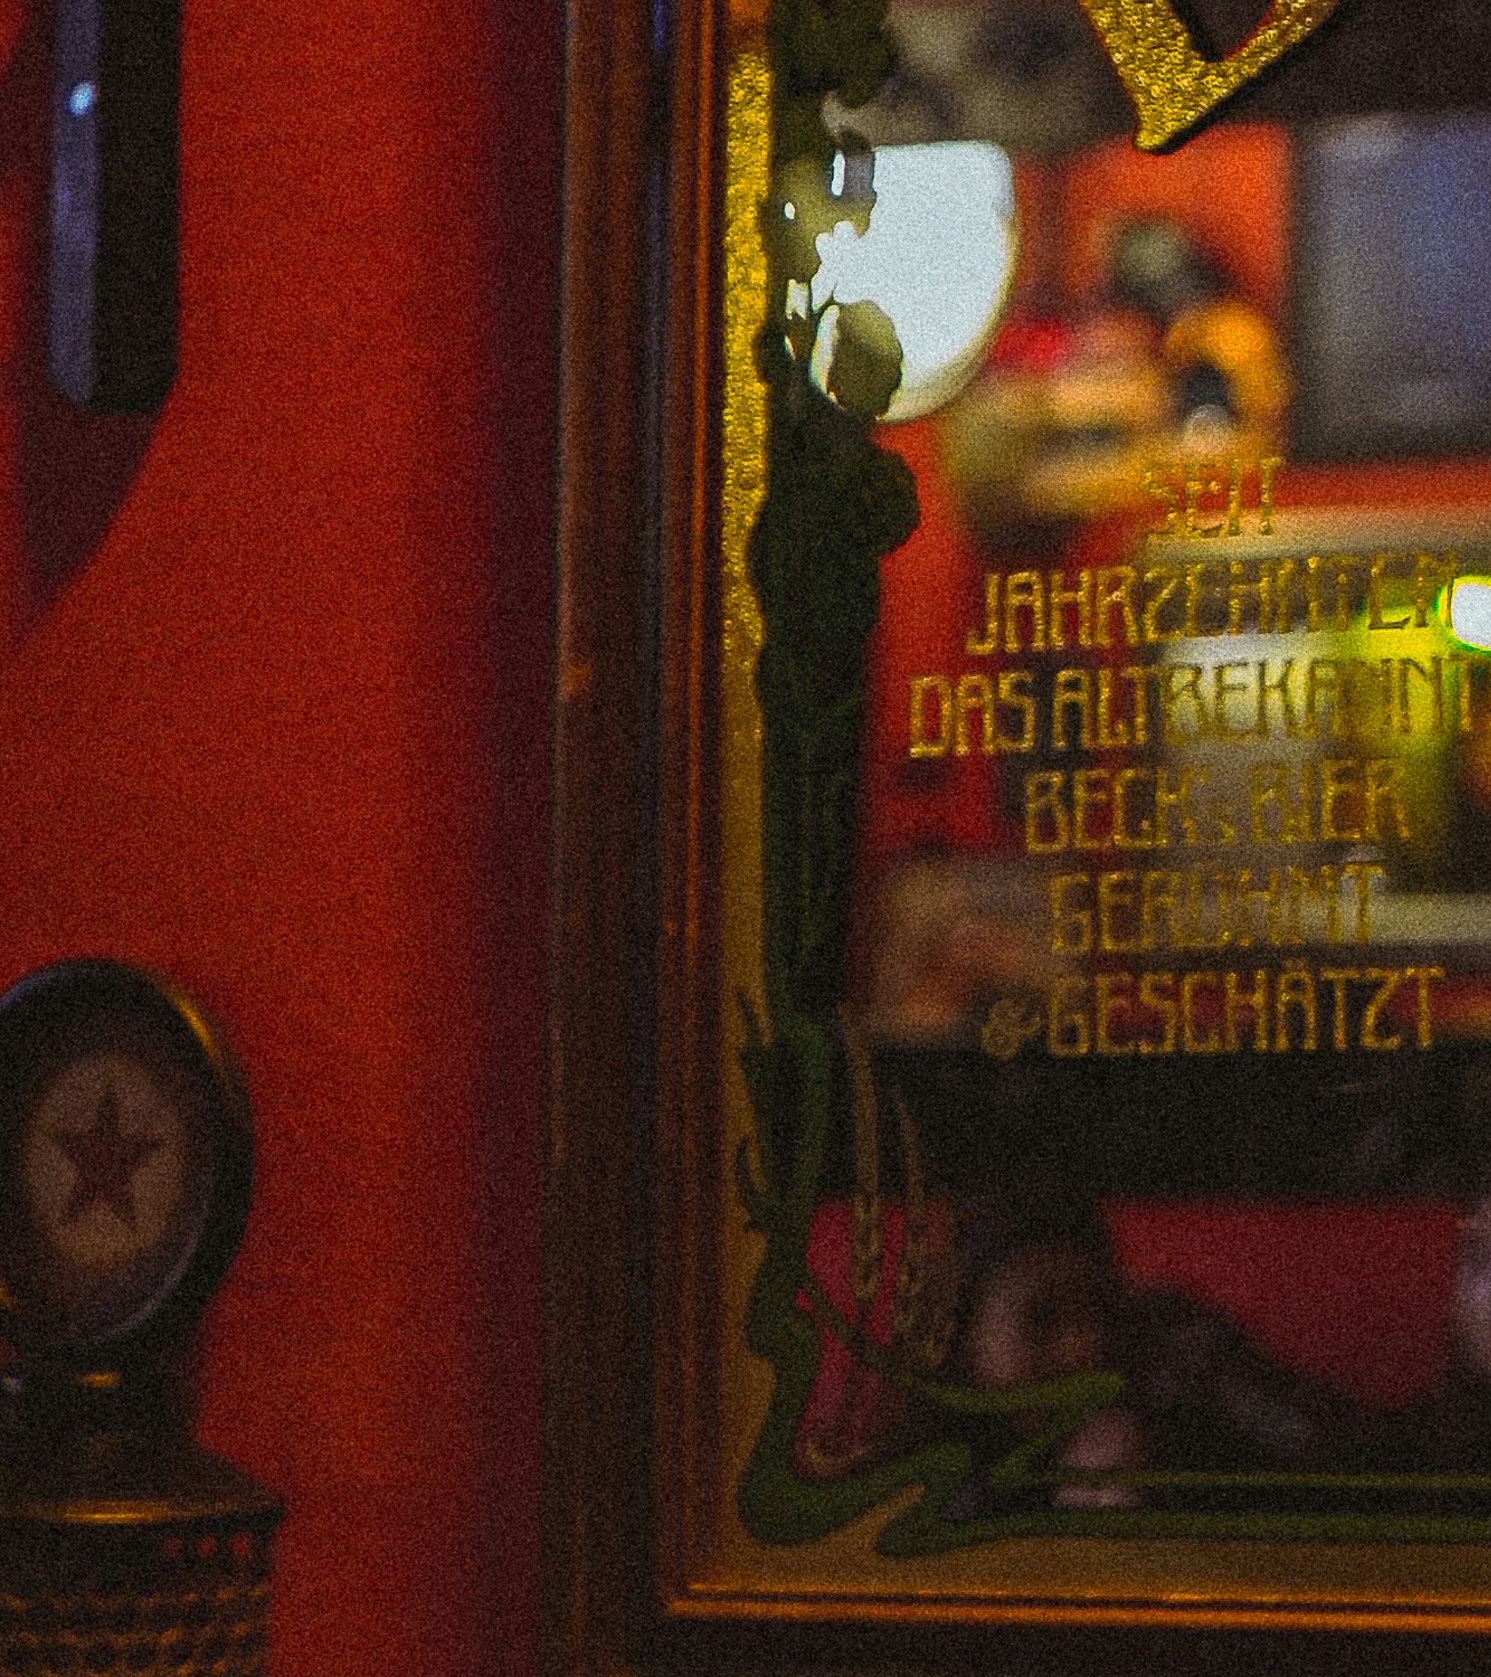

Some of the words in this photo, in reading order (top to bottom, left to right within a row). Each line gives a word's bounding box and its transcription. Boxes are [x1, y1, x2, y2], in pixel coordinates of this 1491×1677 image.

[908, 668, 1036, 760] DAS
[1250, 756, 1413, 844] BIER
[1046, 959, 1445, 1057] GESCHÄTZT
